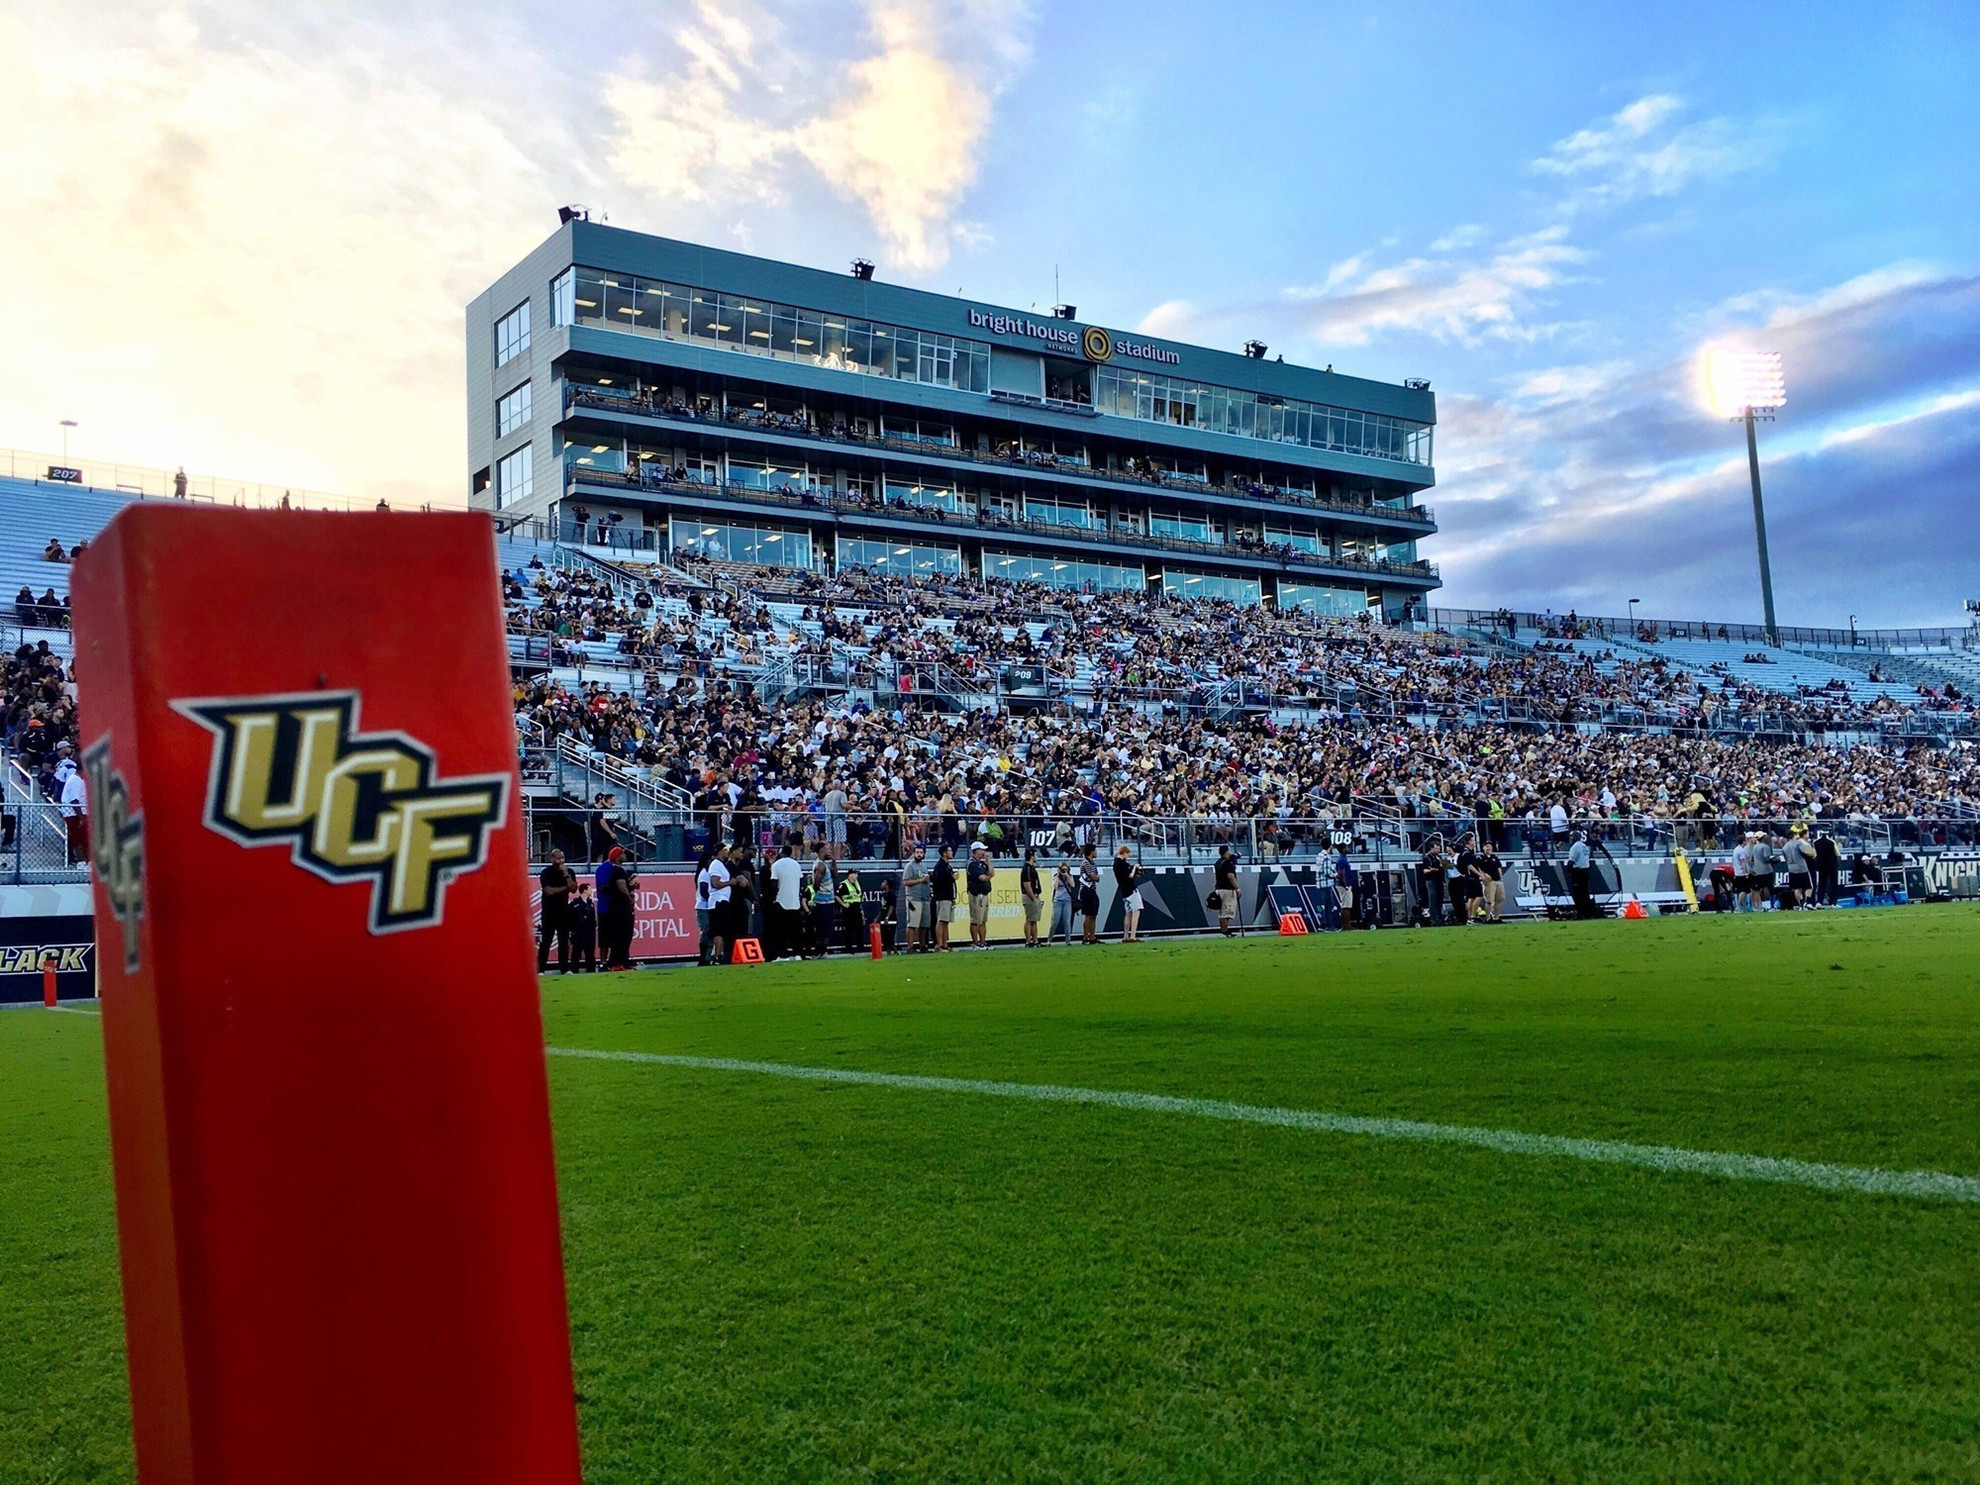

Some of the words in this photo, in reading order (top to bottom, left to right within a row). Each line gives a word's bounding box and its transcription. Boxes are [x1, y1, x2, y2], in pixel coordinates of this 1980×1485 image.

[969, 308, 1024, 335] bright
[1027, 319, 1079, 345] house
[1116, 340, 1181, 365] stadium
[52, 469, 78, 480] 207
[172, 691, 509, 934] UCF
[1030, 830, 1056, 847] 107
[1330, 831, 1352, 845] 108
[1917, 855, 1980, 896] KNIGH
[1289, 915, 1306, 932] 10
[742, 940, 760, 960] G
